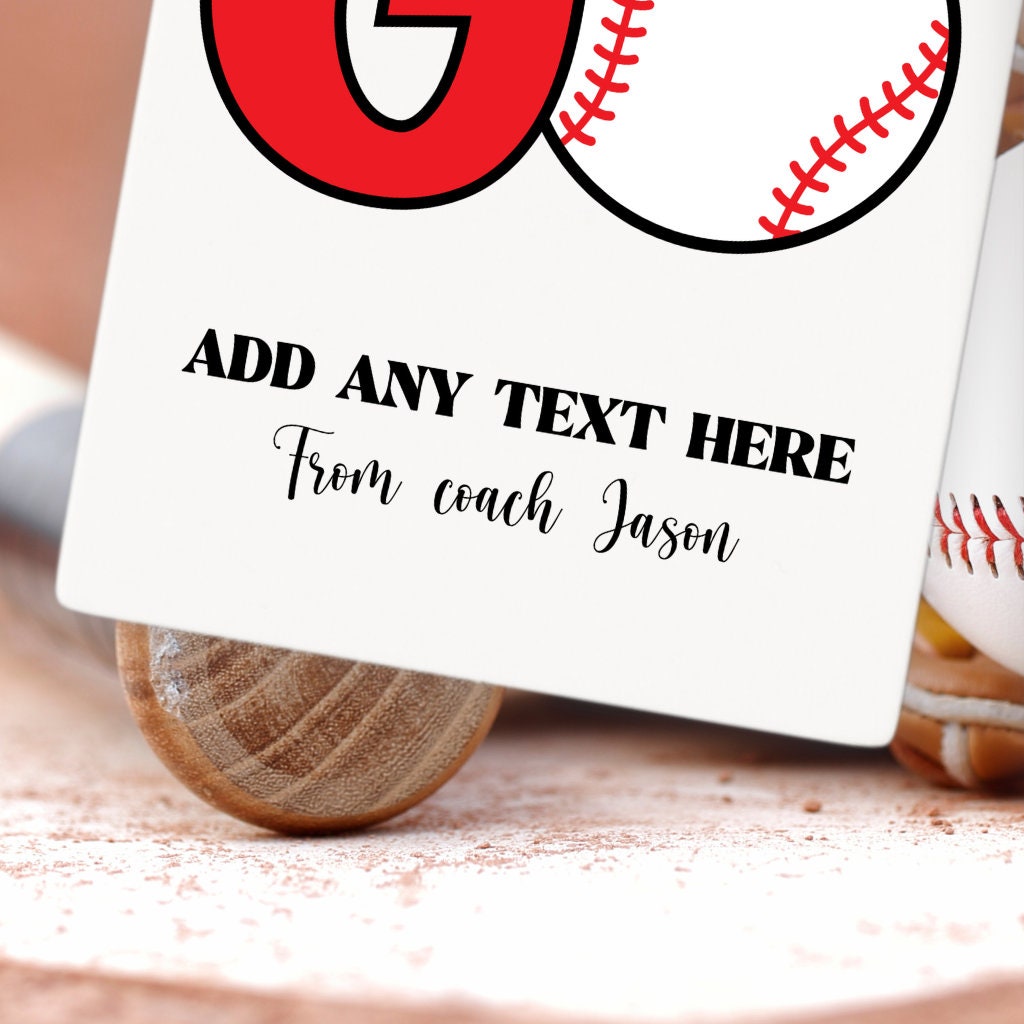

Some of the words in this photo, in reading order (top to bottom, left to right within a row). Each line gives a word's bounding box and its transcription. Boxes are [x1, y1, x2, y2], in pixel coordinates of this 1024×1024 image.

[182, 329, 316, 390] ADD
[335, 355, 473, 417] ANY
[495, 379, 666, 451] TEXT
[686, 412, 856, 485] HERE
[273, 424, 402, 504] From
[433, 471, 563, 535] coach
[593, 478, 740, 563] Jason
